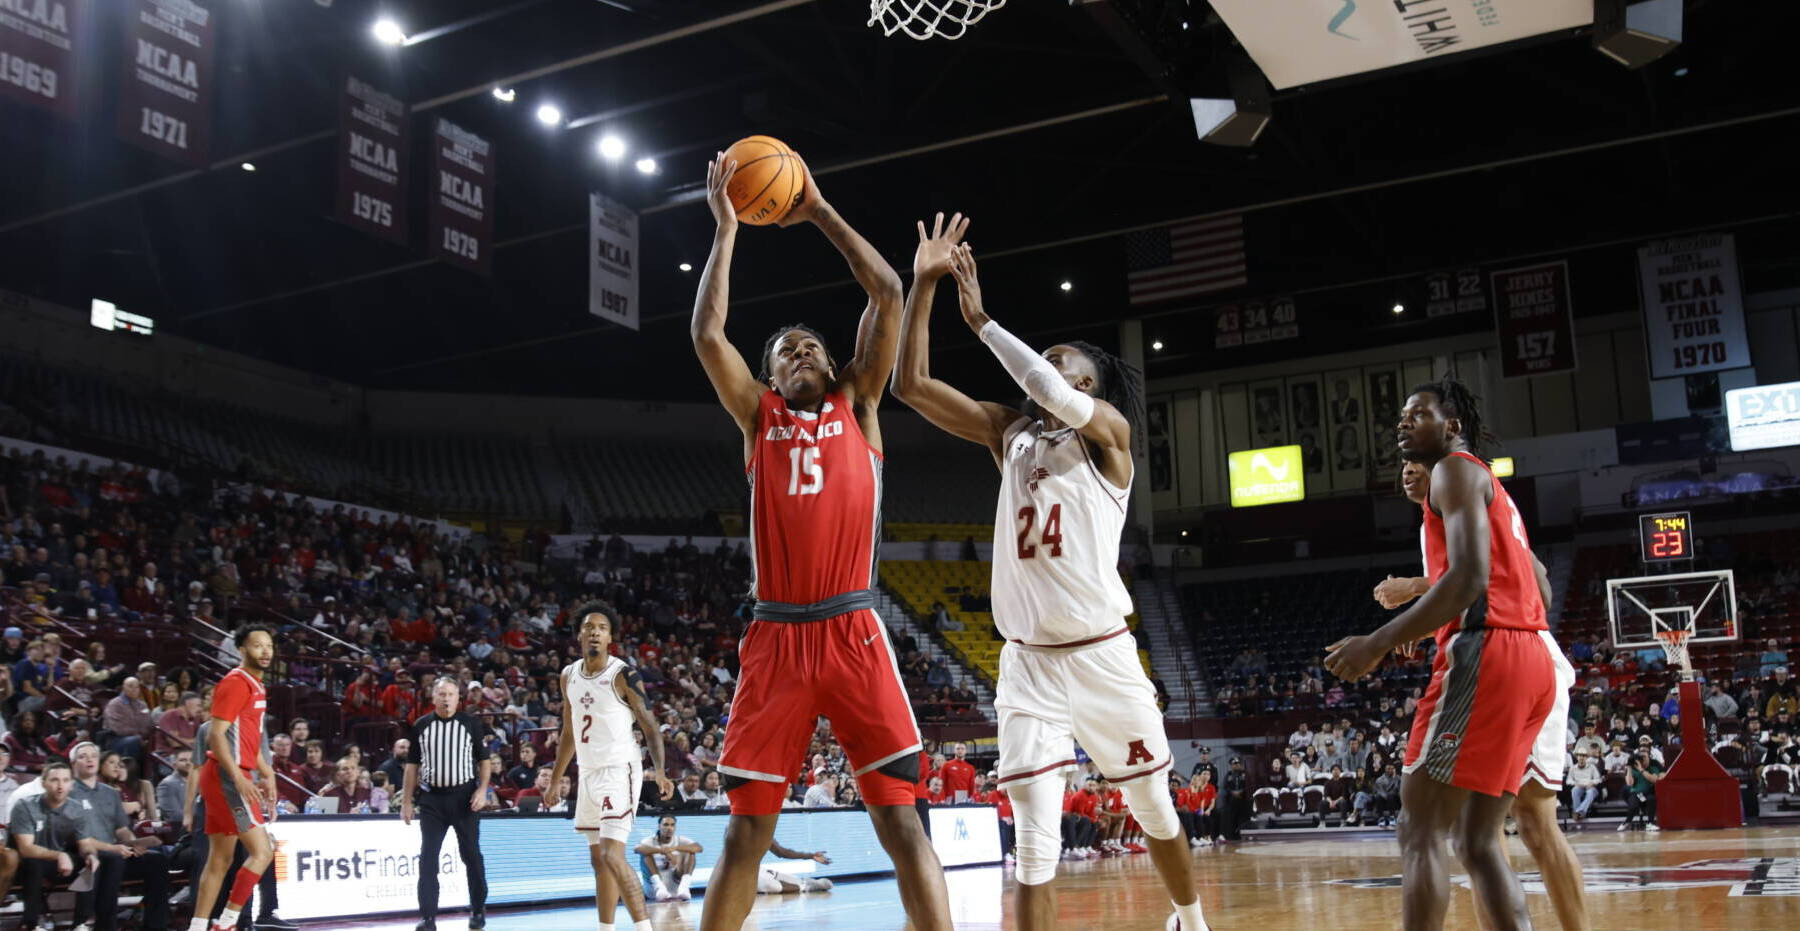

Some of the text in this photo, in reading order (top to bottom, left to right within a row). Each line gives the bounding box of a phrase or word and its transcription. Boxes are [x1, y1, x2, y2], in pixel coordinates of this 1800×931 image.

[0, 51, 57, 99] 1969
[136, 38, 199, 89] NCAA
[141, 106, 187, 149] 1971
[350, 131, 399, 173] NCAA
[440, 169, 484, 209] NCAA
[353, 191, 393, 227] 1975
[443, 226, 478, 260] 1979
[598, 238, 632, 271] NCAA
[1428, 279, 1450, 301] 31
[1457, 275, 1481, 296] 22
[1505, 271, 1554, 292] JERRY
[1658, 274, 1724, 304] NCAA
[601, 287, 628, 317] 1987
[1272, 302, 1297, 322] 40
[1666, 299, 1723, 322] FINAL
[1245, 308, 1268, 328] 34
[1672, 318, 1720, 340] FOUR
[1516, 330, 1556, 360] 157
[1673, 341, 1727, 369] 1970
[787, 446, 824, 496] 15
[1018, 502, 1063, 560] 24
[1655, 517, 1686, 532] 7:44
[1652, 530, 1683, 557] 23
[580, 714, 593, 744] 2
[1126, 738, 1155, 766] A
[601, 795, 614, 812] A
